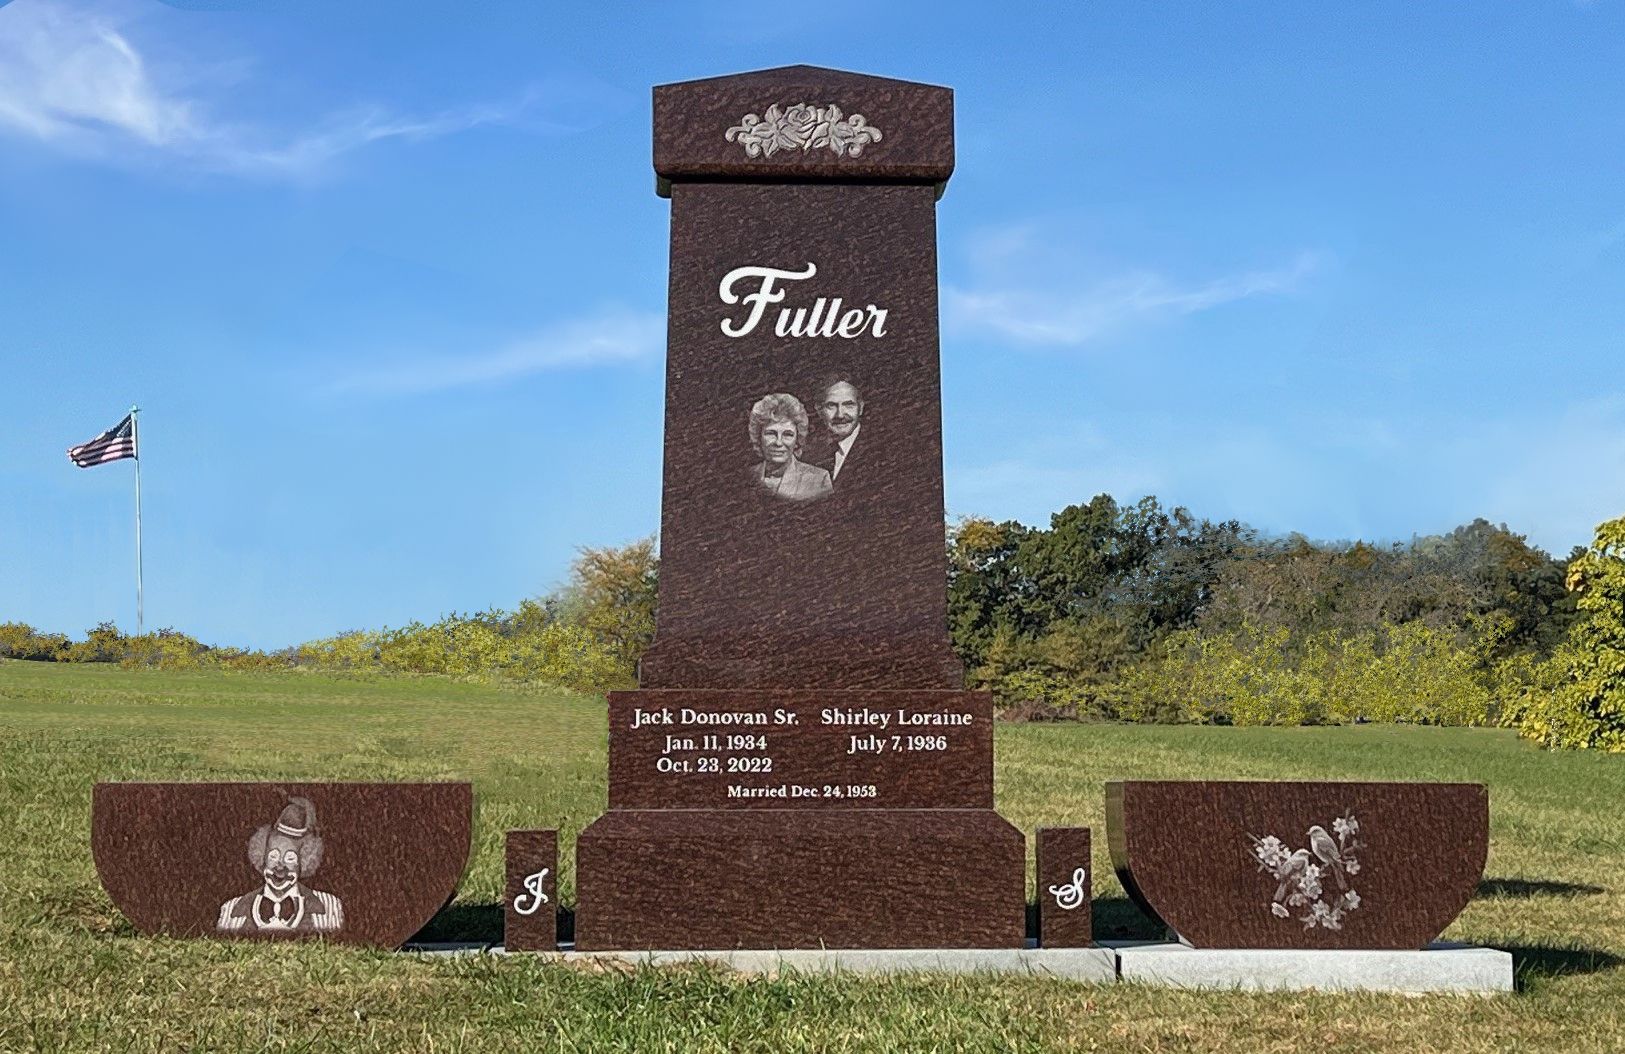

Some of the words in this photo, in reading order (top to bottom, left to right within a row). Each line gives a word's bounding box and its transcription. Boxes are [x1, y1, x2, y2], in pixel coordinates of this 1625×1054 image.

[719, 262, 888, 338] Fuller
[632, 708, 673, 728] Jack
[681, 709, 767, 724] Donovan
[774, 709, 799, 725] Sr.
[821, 708, 891, 729] Shirley
[898, 710, 972, 725] Loraine
[662, 735, 699, 754] Jan.
[726, 735, 768, 750] 1934
[847, 734, 887, 755] July
[656, 757, 693, 773] Oct.
[697, 757, 723, 774] 23,
[727, 757, 773, 773] 2022
[727, 784, 787, 798] Married
[791, 784, 820, 798] Dec.
[1049, 868, 1086, 910] S
